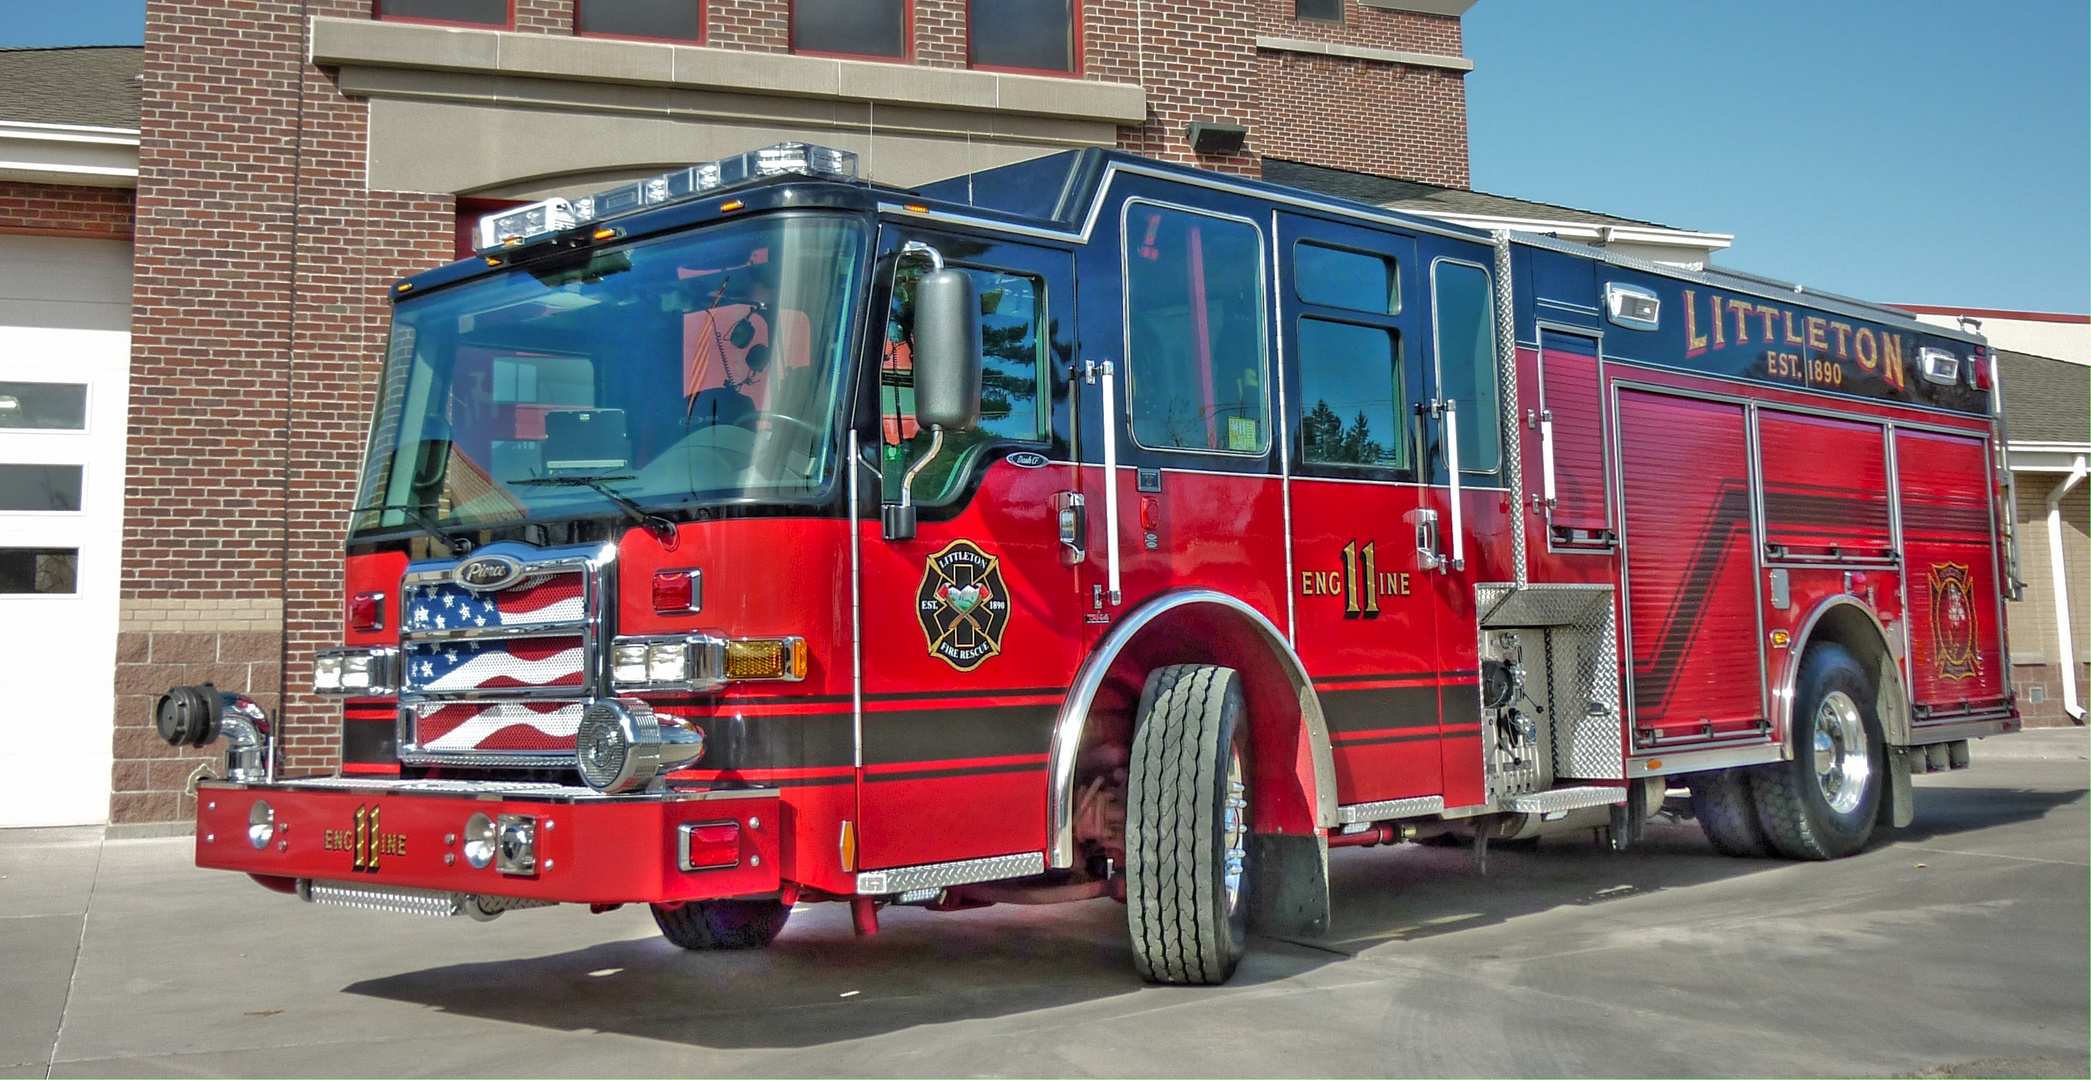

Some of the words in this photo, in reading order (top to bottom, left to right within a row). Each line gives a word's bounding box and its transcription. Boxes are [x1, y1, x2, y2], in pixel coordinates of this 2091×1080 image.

[1683, 290, 1905, 391] LITTLETON
[1767, 351, 1802, 379] EST.
[1807, 359, 1842, 386] 1890
[466, 563, 506, 582] Pierce
[938, 551, 988, 569] LITTLETON
[1341, 540, 1380, 620] 11
[921, 600, 939, 610] EST.
[989, 601, 1005, 610] 1890
[940, 641, 959, 659] FIRE
[959, 641, 990, 660] RESCUE
[352, 803, 381, 874] 11
